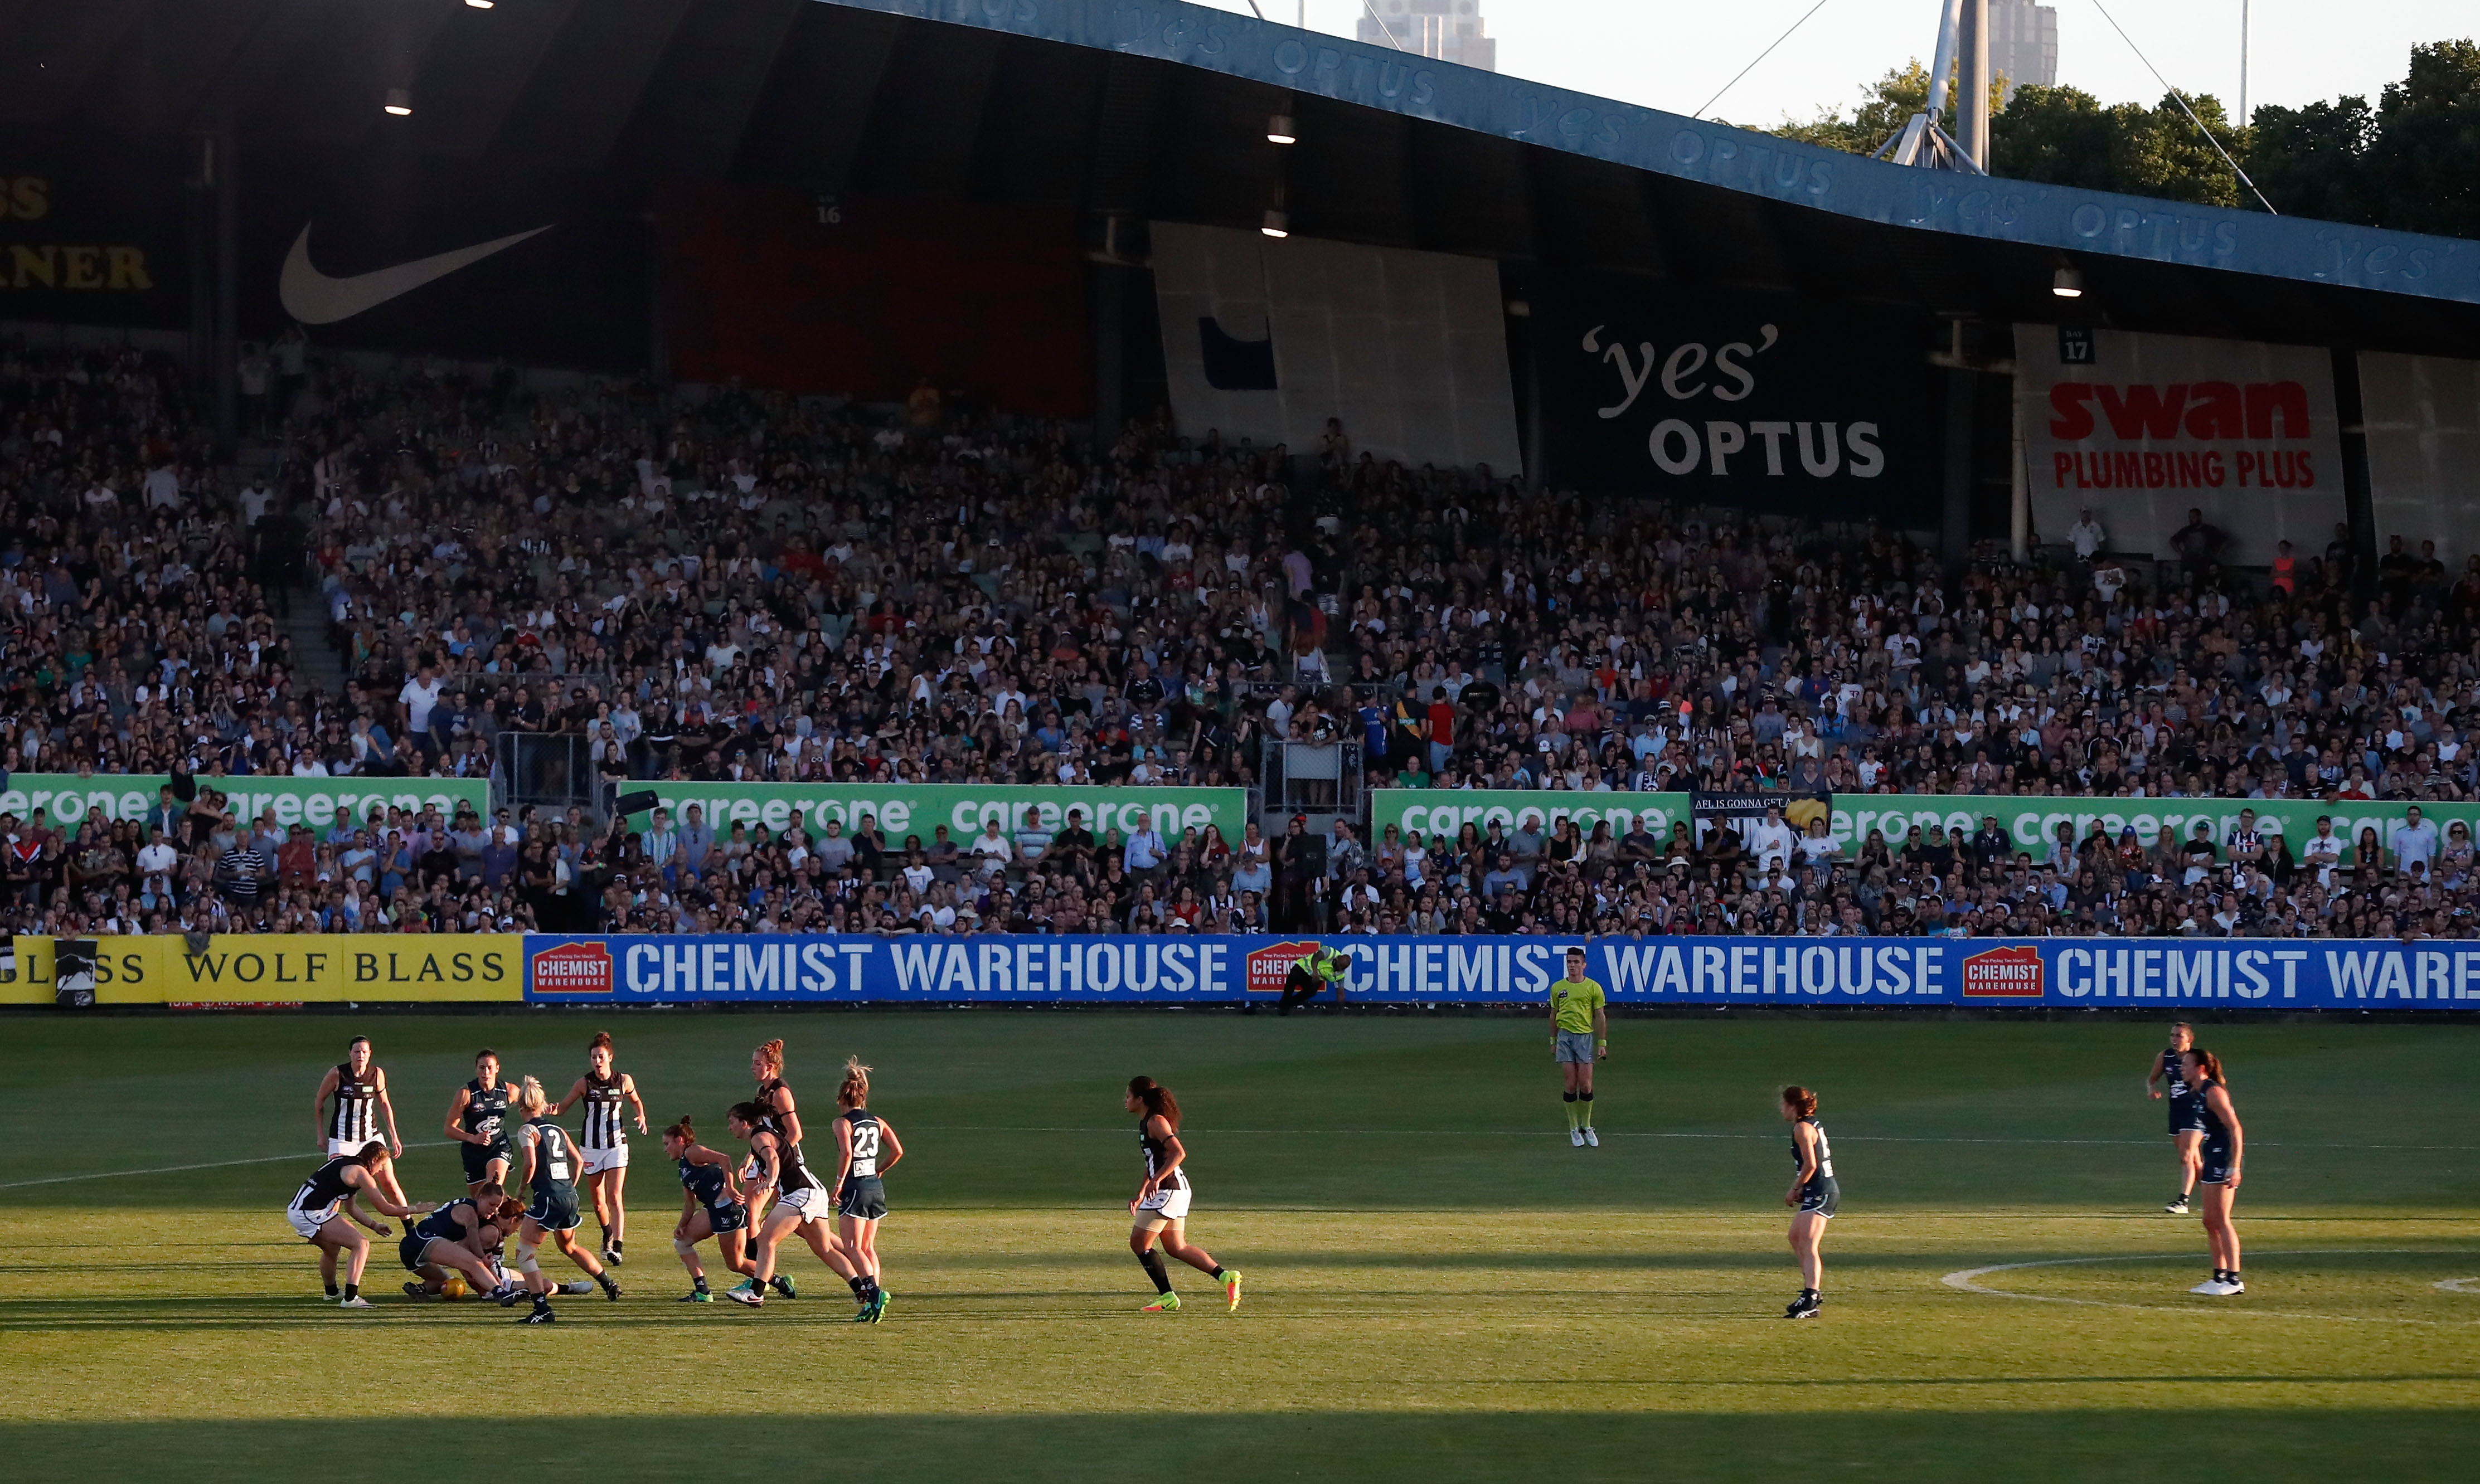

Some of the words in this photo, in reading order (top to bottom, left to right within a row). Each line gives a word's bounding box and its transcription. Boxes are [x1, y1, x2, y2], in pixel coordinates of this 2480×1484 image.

[1273, 38, 1436, 105] OPTUS
[1671, 129, 1833, 195] OPTUS
[2071, 203, 2238, 256] OPTUS
[816, 206, 842, 223] 16
[0, 244, 153, 291] NER
[2065, 340, 2088, 360] 17
[2049, 380, 2311, 440] swan
[1648, 418, 1886, 479] OPTUS
[2054, 450, 2226, 488] PLUMBING
[2237, 450, 2315, 488] PLUS
[195, 791, 453, 827] areerone
[952, 800, 1213, 835] careerone
[1695, 799, 1714, 809] AFL
[1716, 799, 1725, 808] IS
[1726, 799, 1761, 808] GONNA
[1401, 805, 1667, 841] careerone
[183, 953, 328, 982] WOLF
[354, 952, 504, 982] BLASS
[537, 960, 608, 976] CHEMIST
[538, 977, 605, 986] WAREHOUSE
[625, 943, 873, 994] CHEMIST
[889, 943, 1227, 992] WAREHOUSE
[1604, 945, 1943, 995] WAREHOUSE
[1968, 965, 2039, 980] CHEMIST
[2057, 948, 2308, 999] CHEMIST
[1969, 982, 2036, 990] WAREHOUSE
[547, 1128, 564, 1157] 2
[853, 1126, 879, 1157] 23
